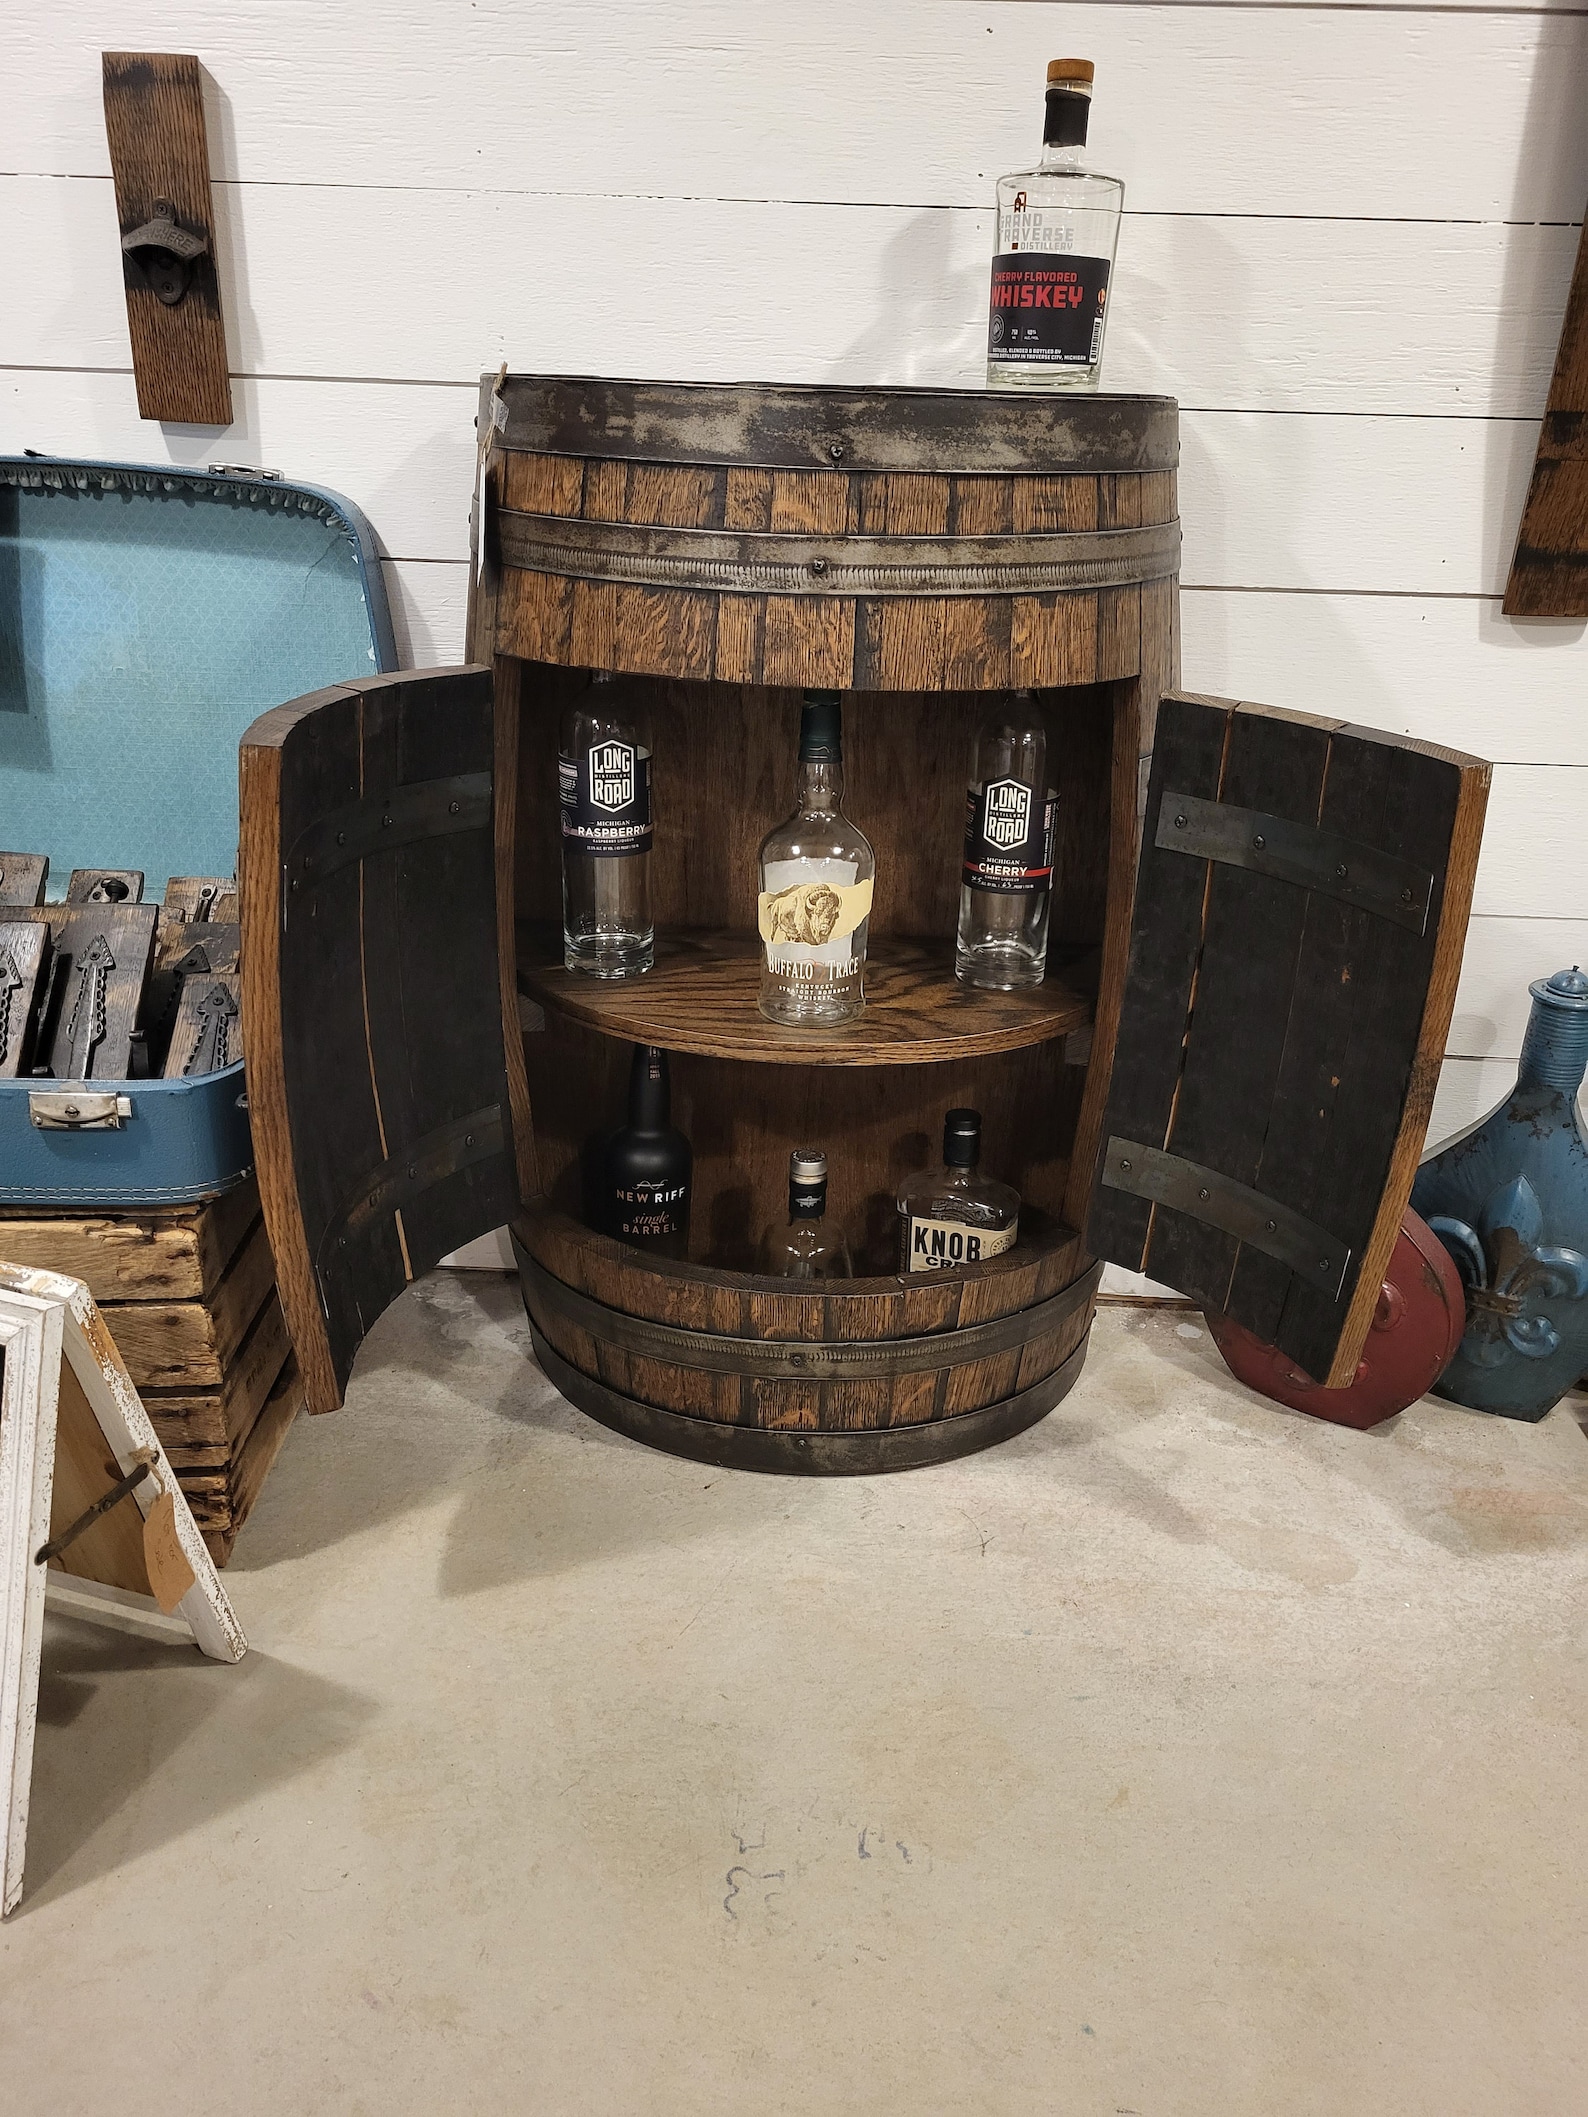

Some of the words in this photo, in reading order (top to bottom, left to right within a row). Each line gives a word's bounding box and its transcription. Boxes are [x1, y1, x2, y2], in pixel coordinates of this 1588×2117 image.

[1001, 227, 1074, 242] RAVERSE
[1020, 242, 1073, 251] DISTILLERY
[994, 272, 1023, 283] CHERRY
[1024, 272, 1078, 283] FLAVORED
[991, 285, 1084, 309] WHISKEY
[594, 748, 630, 774] LONG
[594, 778, 630, 805] ROAD
[989, 786, 1027, 813] LONG
[596, 819, 631, 827] MICHIGAN
[988, 816, 1024, 843] ROAD
[578, 824, 646, 838] RASPBERRY
[986, 857, 1020, 865] MICHIGAN
[978, 863, 1028, 876] CHERRY
[767, 952, 813, 981] BUFFALO
[828, 956, 859, 981] TRACE
[778, 985, 814, 995] STRAIGHT
[817, 986, 850, 995] BOURBON
[616, 1189, 649, 1204] NEW
[654, 1186, 686, 1204] RIFF
[632, 1210, 670, 1227] single
[622, 1222, 678, 1235] BARREL
[914, 1225, 981, 1262] KNOB
[925, 1256, 968, 1269] CR
